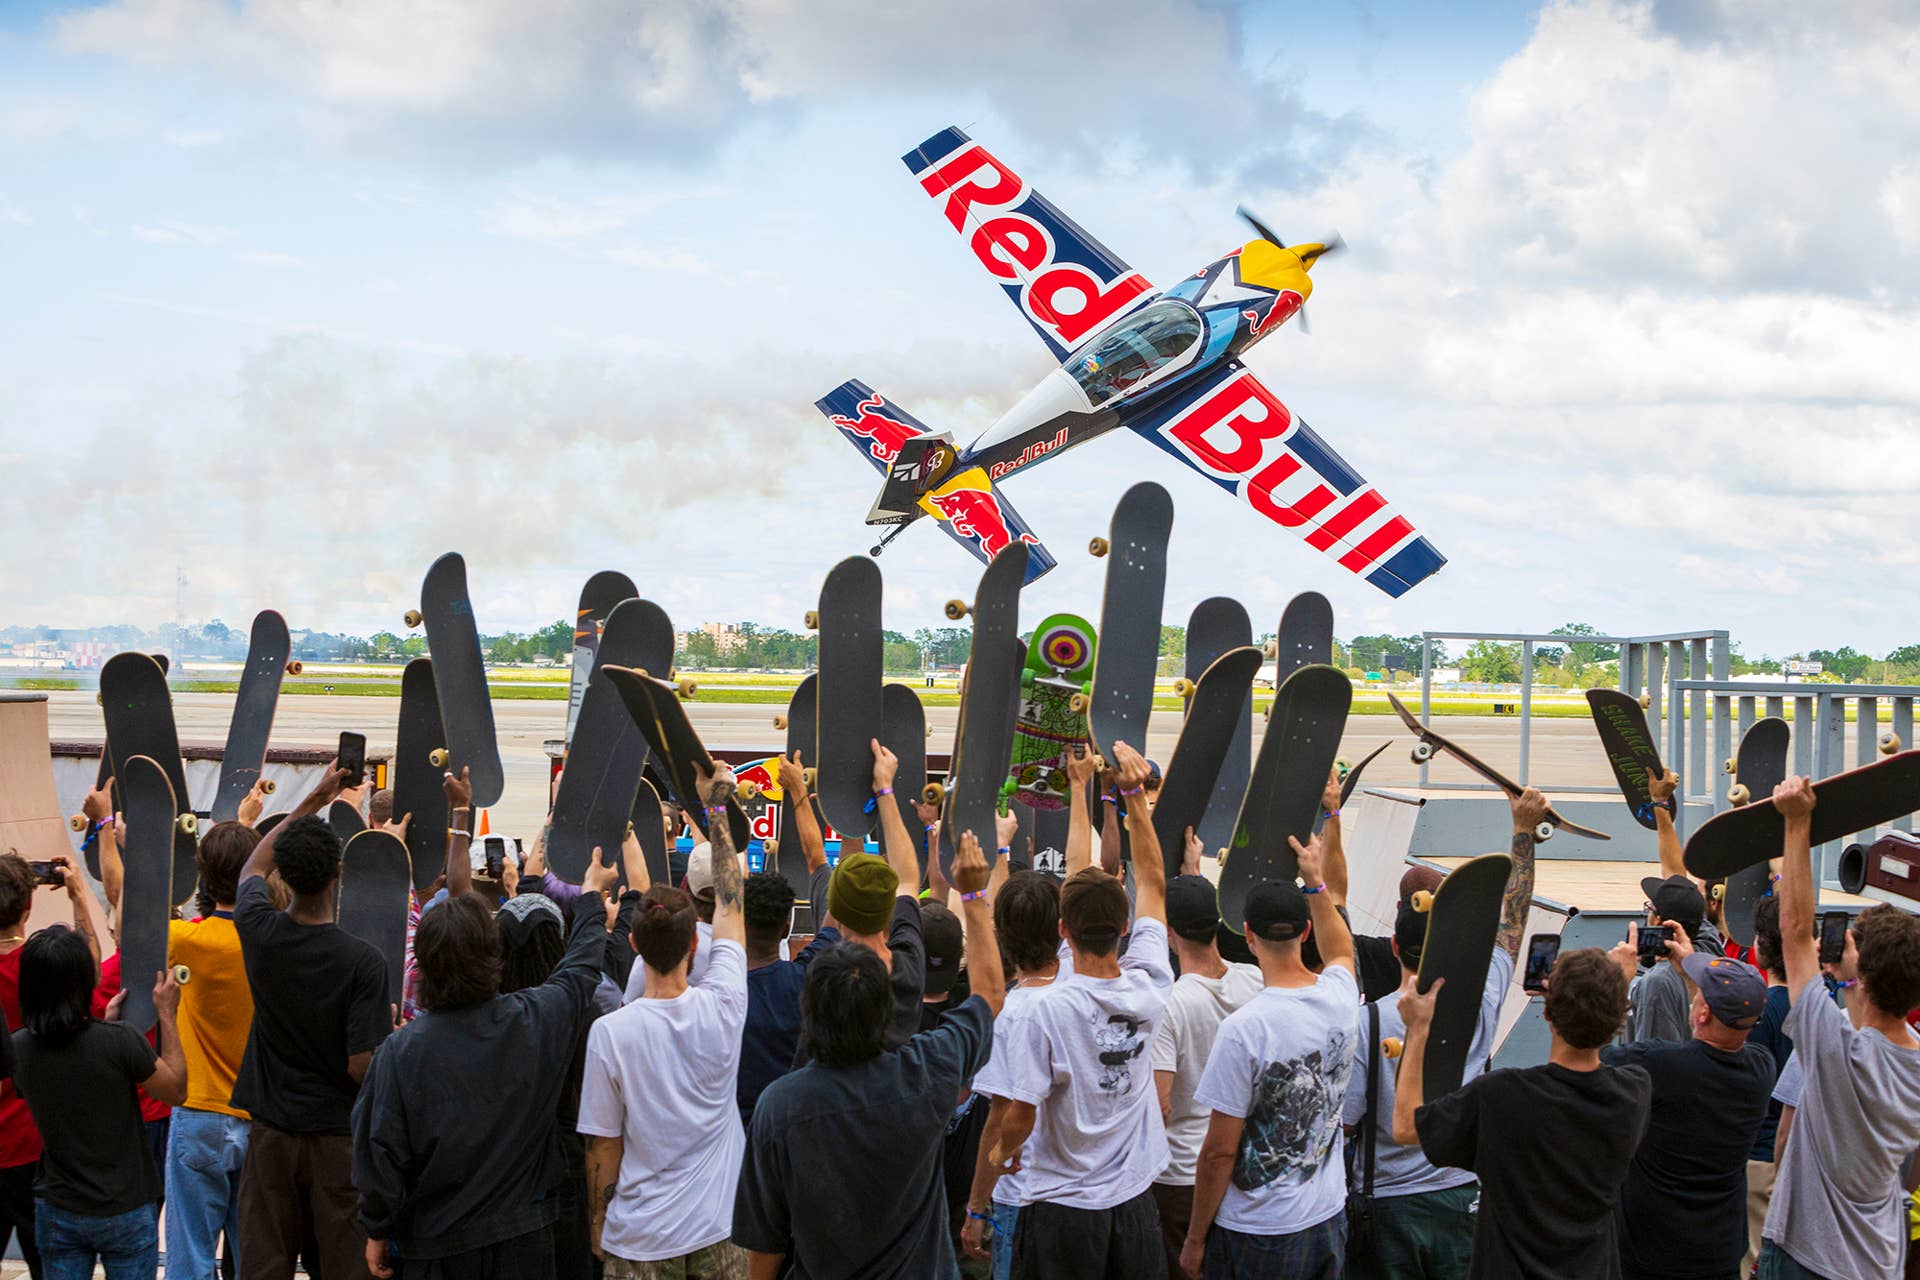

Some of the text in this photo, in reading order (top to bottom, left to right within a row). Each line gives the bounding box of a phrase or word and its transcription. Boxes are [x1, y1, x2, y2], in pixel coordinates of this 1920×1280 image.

[918, 143, 1418, 576] Red Bull
[990, 426, 1069, 481] Red Bull
